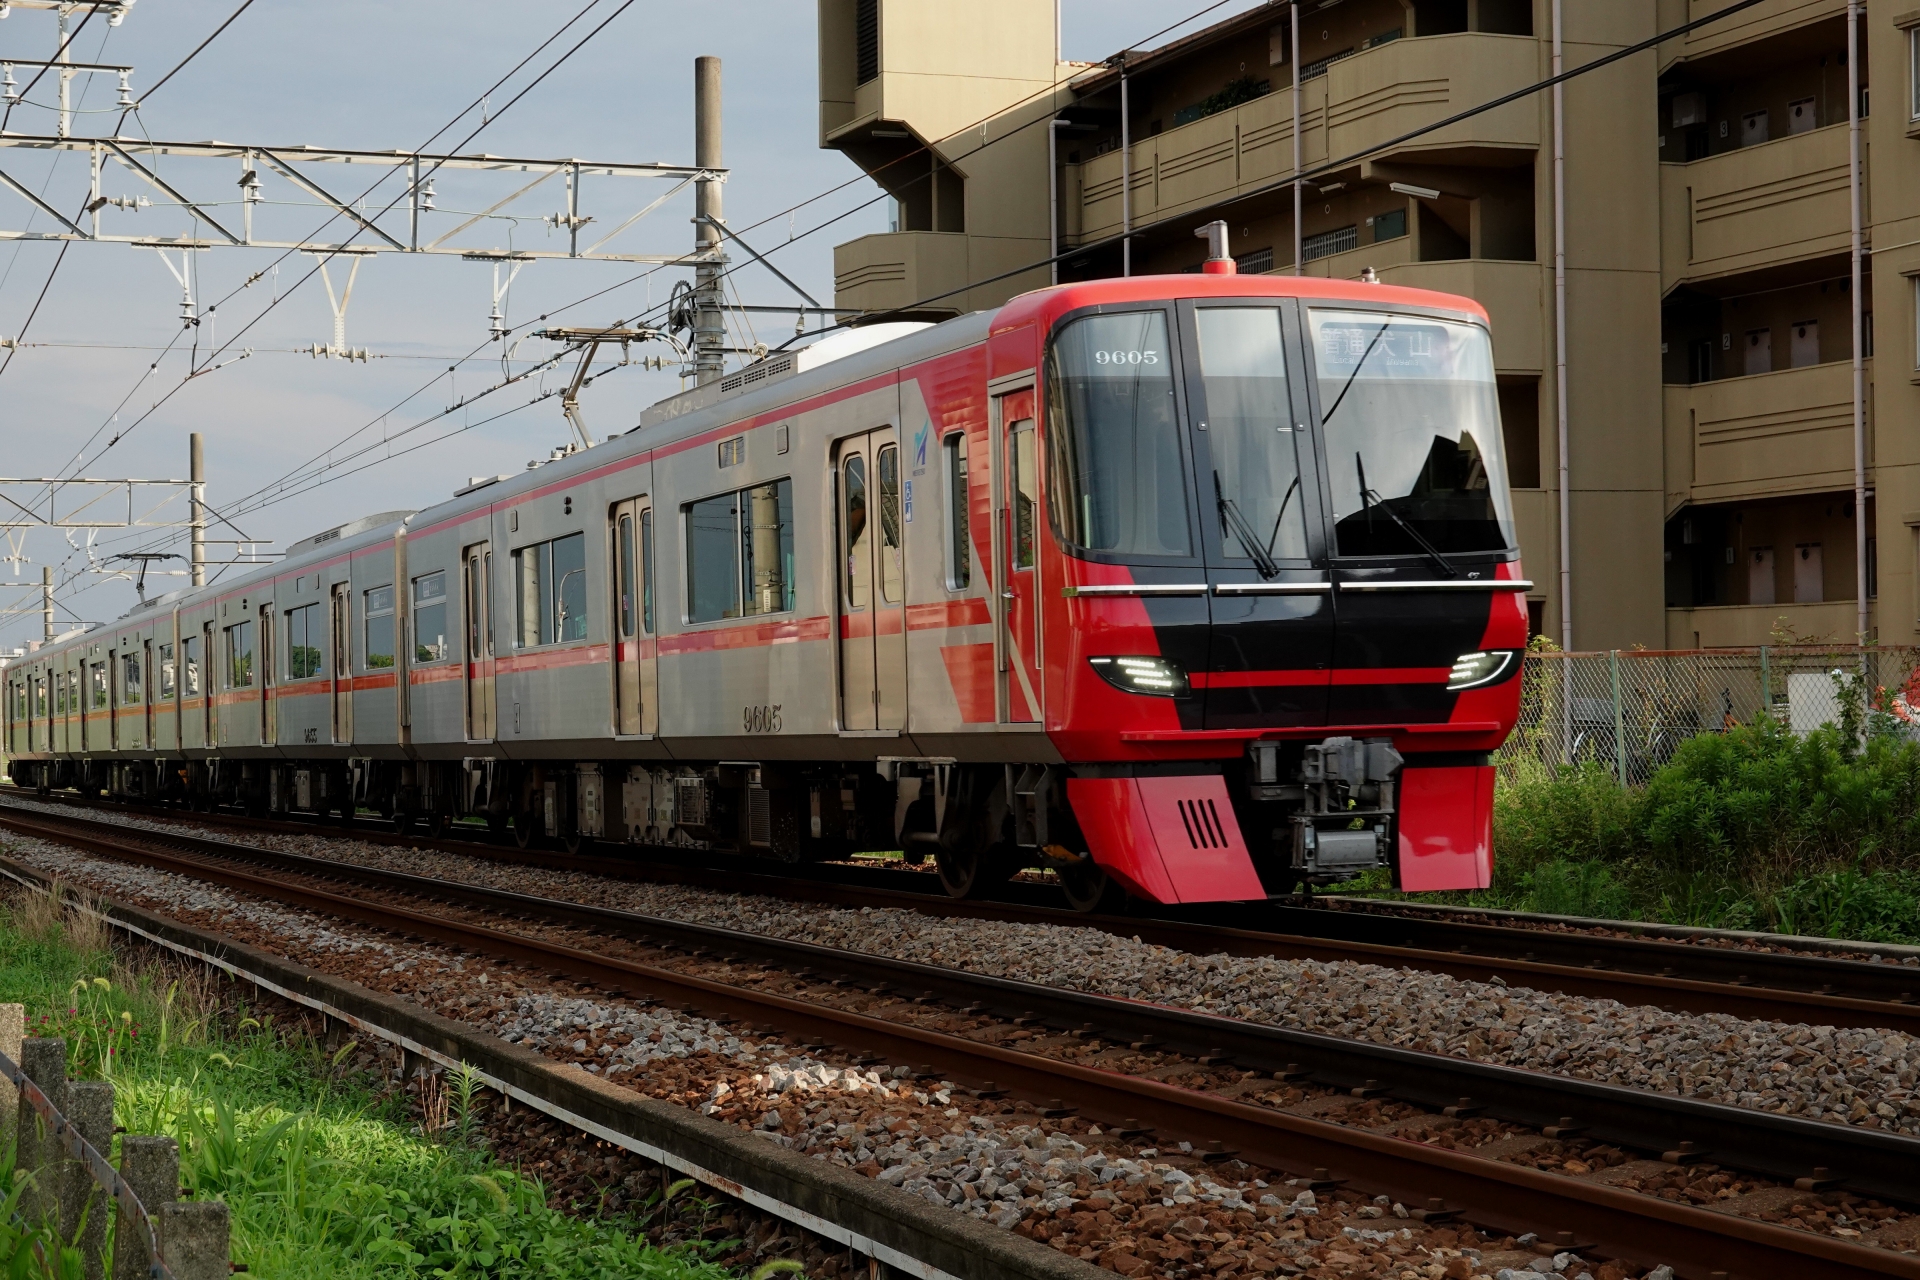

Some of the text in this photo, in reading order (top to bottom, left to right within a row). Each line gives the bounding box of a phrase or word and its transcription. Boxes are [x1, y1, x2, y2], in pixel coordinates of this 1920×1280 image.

[1721, 123, 1727, 135] 3
[1321, 328, 1431, 357] 普通 犬山
[1724, 335, 1729, 348] 2
[1094, 350, 1158, 364] 9605
[743, 704, 782, 732] 9605
